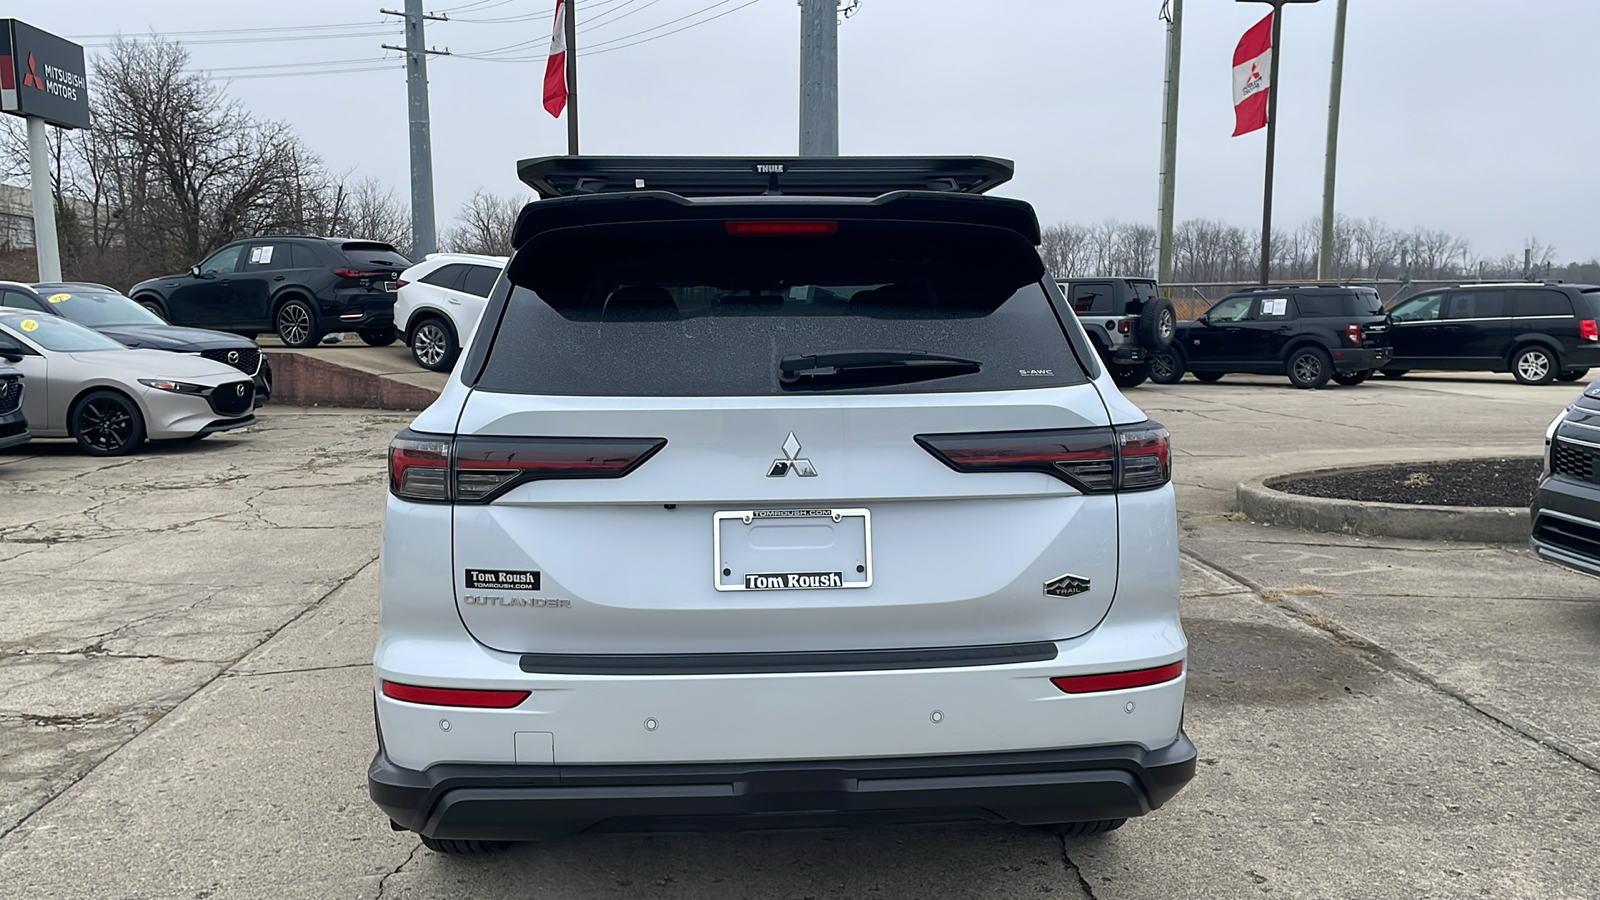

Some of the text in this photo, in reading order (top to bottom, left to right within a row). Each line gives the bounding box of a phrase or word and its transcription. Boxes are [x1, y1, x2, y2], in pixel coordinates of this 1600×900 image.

[44, 64, 85, 90] MITSUBISHI
[46, 79, 77, 101] MOTORS
[757, 165, 783, 173] THULE
[471, 571, 535, 583] Tom Roush
[746, 573, 841, 589] Tom Roush
[464, 595, 572, 608] OUTLANDER
